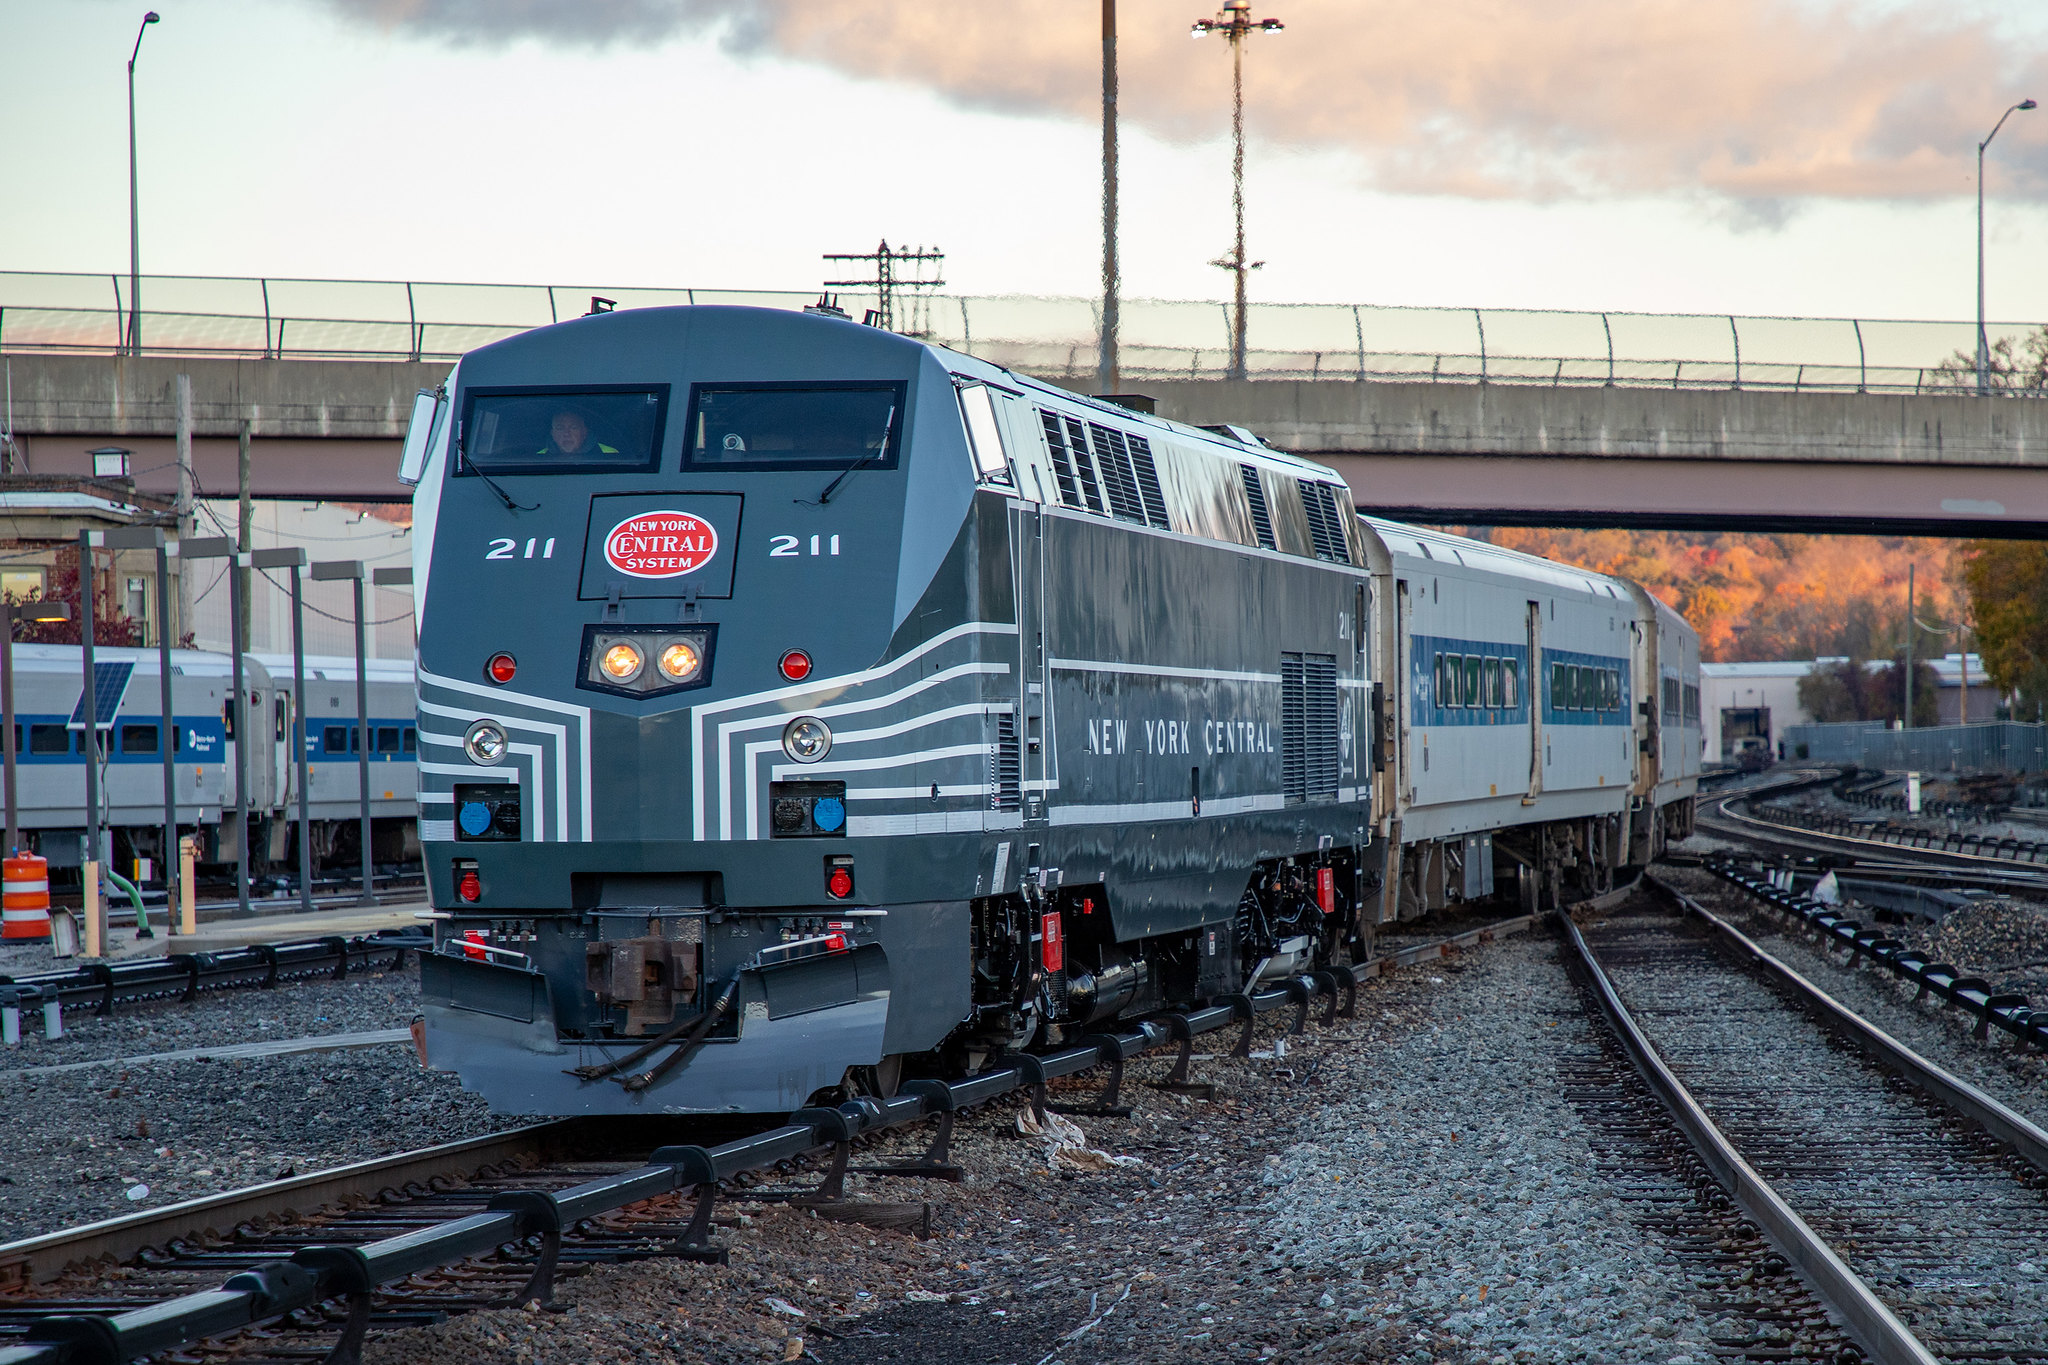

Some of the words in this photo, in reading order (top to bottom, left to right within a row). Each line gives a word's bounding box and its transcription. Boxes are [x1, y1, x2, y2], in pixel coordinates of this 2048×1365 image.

[629, 521, 658, 532] NEW
[660, 520, 697, 531] YORK
[485, 537, 556, 560] 211
[610, 532, 712, 559] CENTRAL
[769, 534, 840, 557] 211
[625, 557, 692, 569] SYSTEM
[1339, 611, 1350, 641] 211
[1089, 719, 1127, 755] NEW
[1145, 719, 1190, 756] YORK
[1205, 719, 1274, 756] CENTRAL
